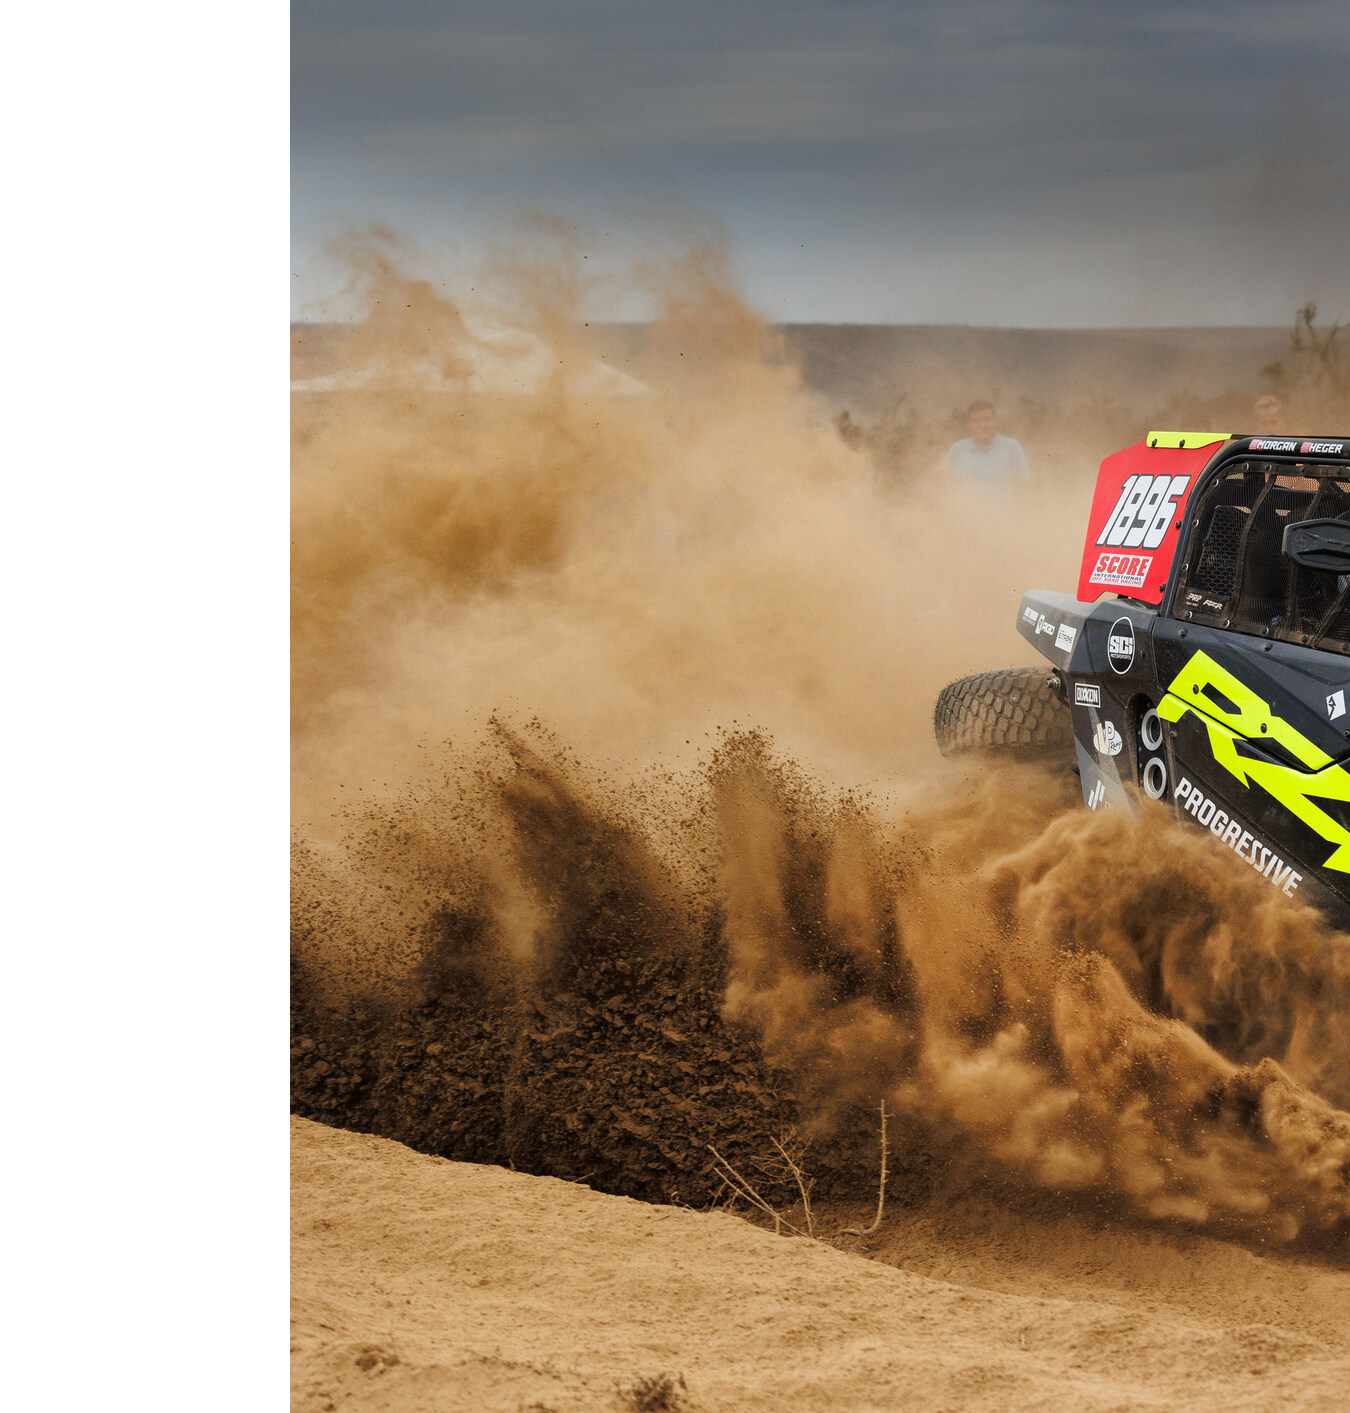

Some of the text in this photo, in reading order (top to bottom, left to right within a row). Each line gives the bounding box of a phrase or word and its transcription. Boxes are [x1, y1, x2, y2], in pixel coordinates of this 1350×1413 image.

[1256, 440, 1343, 454] MORGAN HEGER
[1095, 474, 1191, 550] 1896
[1093, 572, 1142, 581] INTERNATIONAL
[1096, 555, 1150, 577] SCORE
[1173, 776, 1303, 898] PROGRESSIVE
